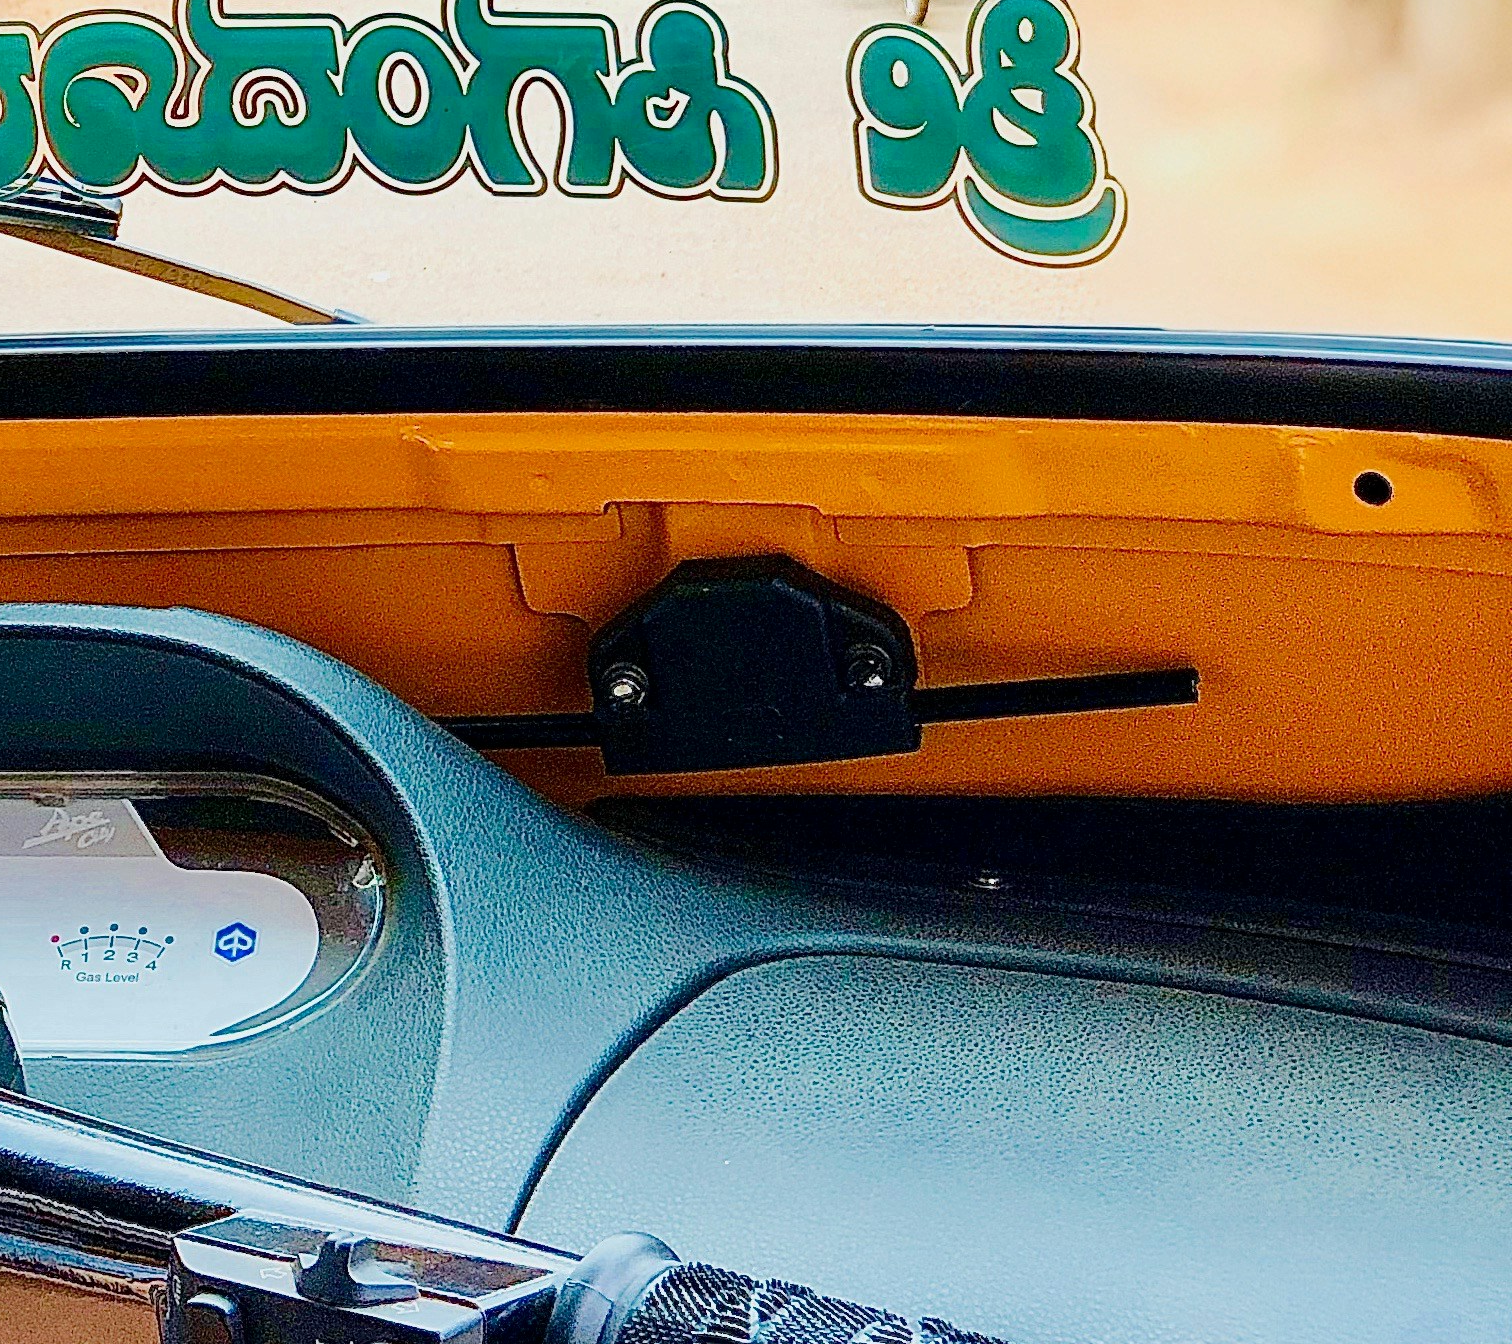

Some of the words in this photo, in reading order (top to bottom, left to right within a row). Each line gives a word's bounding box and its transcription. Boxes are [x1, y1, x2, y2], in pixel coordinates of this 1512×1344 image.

[61, 959, 71, 970] R
[81, 952, 88, 962] 1
[103, 949, 116, 961] 2
[127, 952, 139, 963] 3
[145, 960, 157, 971] 4
[76, 972, 101, 982] Gas
[105, 972, 139, 983] Level
